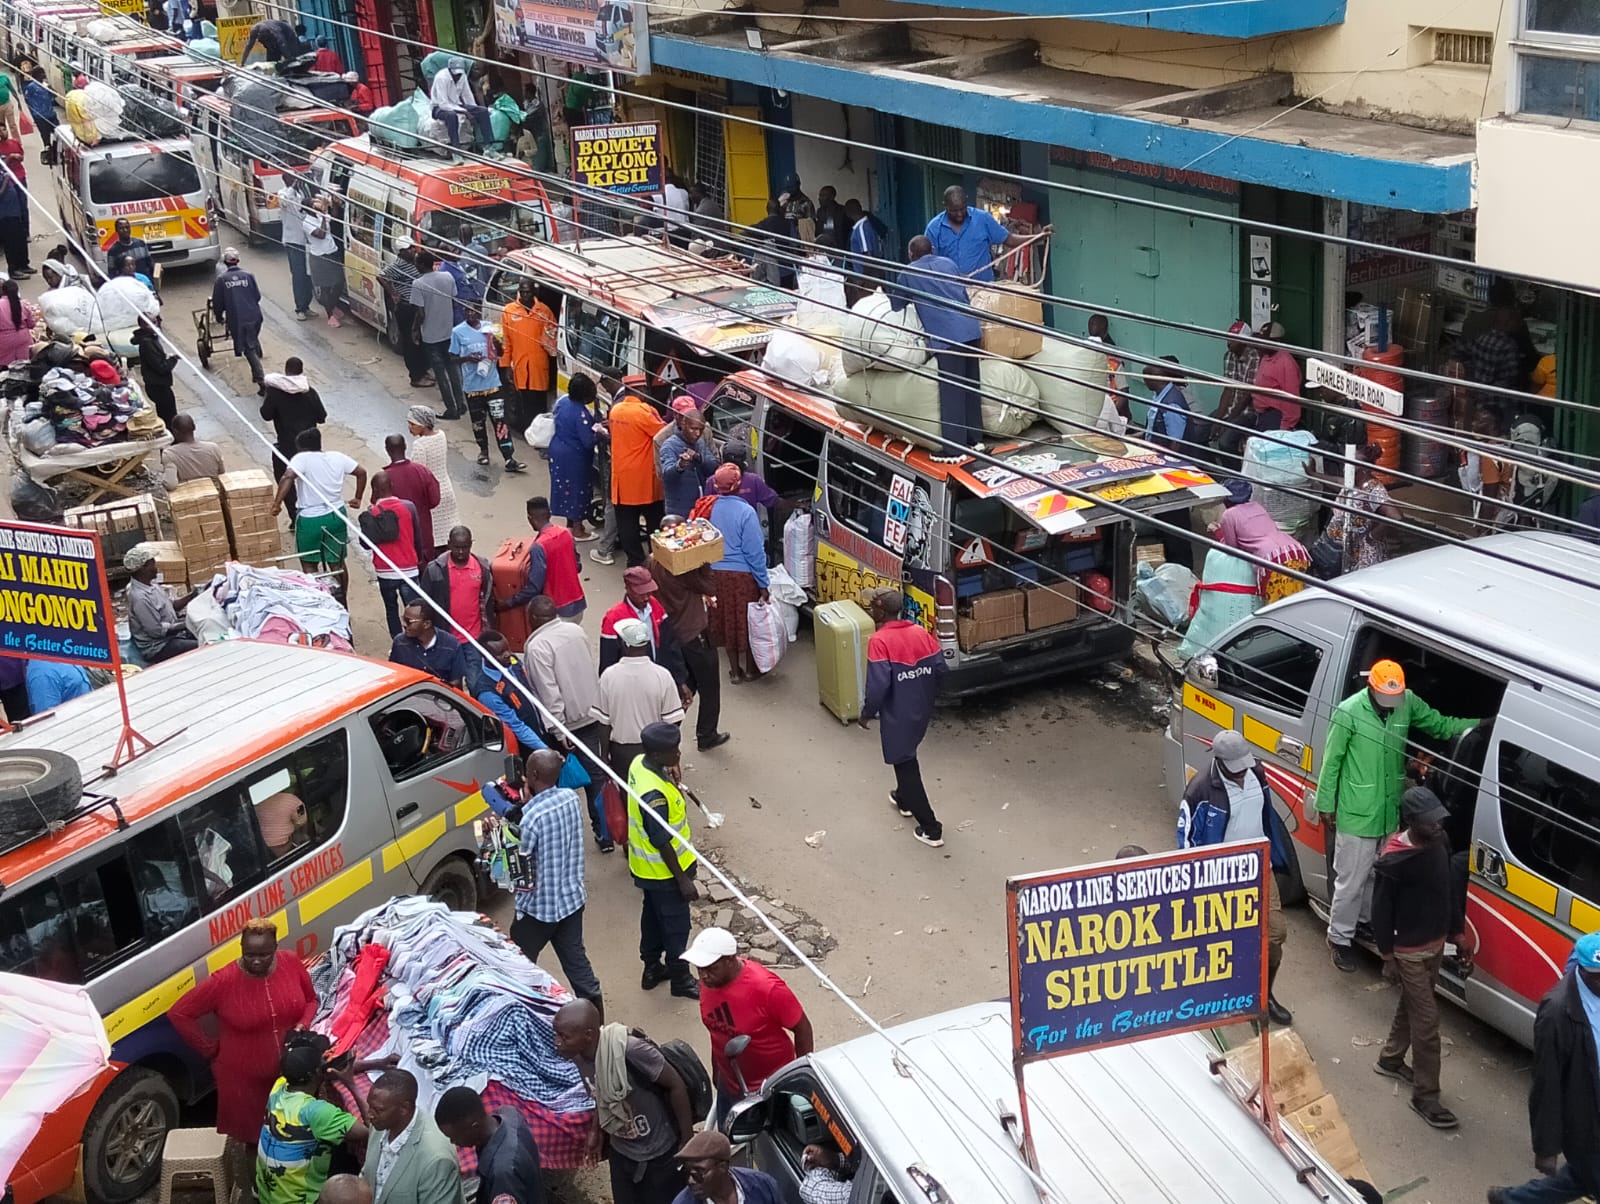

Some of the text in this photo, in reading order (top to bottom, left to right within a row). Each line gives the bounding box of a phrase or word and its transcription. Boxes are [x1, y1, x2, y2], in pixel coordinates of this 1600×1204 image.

[534, 22, 586, 45] PARCEL SERVICES
[578, 136, 656, 156] BOMET
[576, 151, 658, 172] KAPLONG
[586, 168, 649, 188] KISII
[1345, 259, 1400, 285] lectrical
[1316, 366, 1385, 408] CHARLES RUBIA ROAD
[892, 479, 912, 503] FAI
[15, 531, 58, 556] SERVICES
[56, 536, 96, 560] LIMITED
[18, 555, 89, 591] MAHIU
[4, 632, 109, 660] the Better Services
[208, 902, 254, 947] NAROK
[256, 879, 288, 919] LINE
[289, 843, 346, 897] SERVICES
[1019, 852, 1260, 917] NAROK LINE SERVICES LIMITED
[1024, 886, 1260, 965] NAROK LINE
[1045, 939, 1234, 1012] SHUTTLE
[1027, 993, 1255, 1051] For the Better Services
